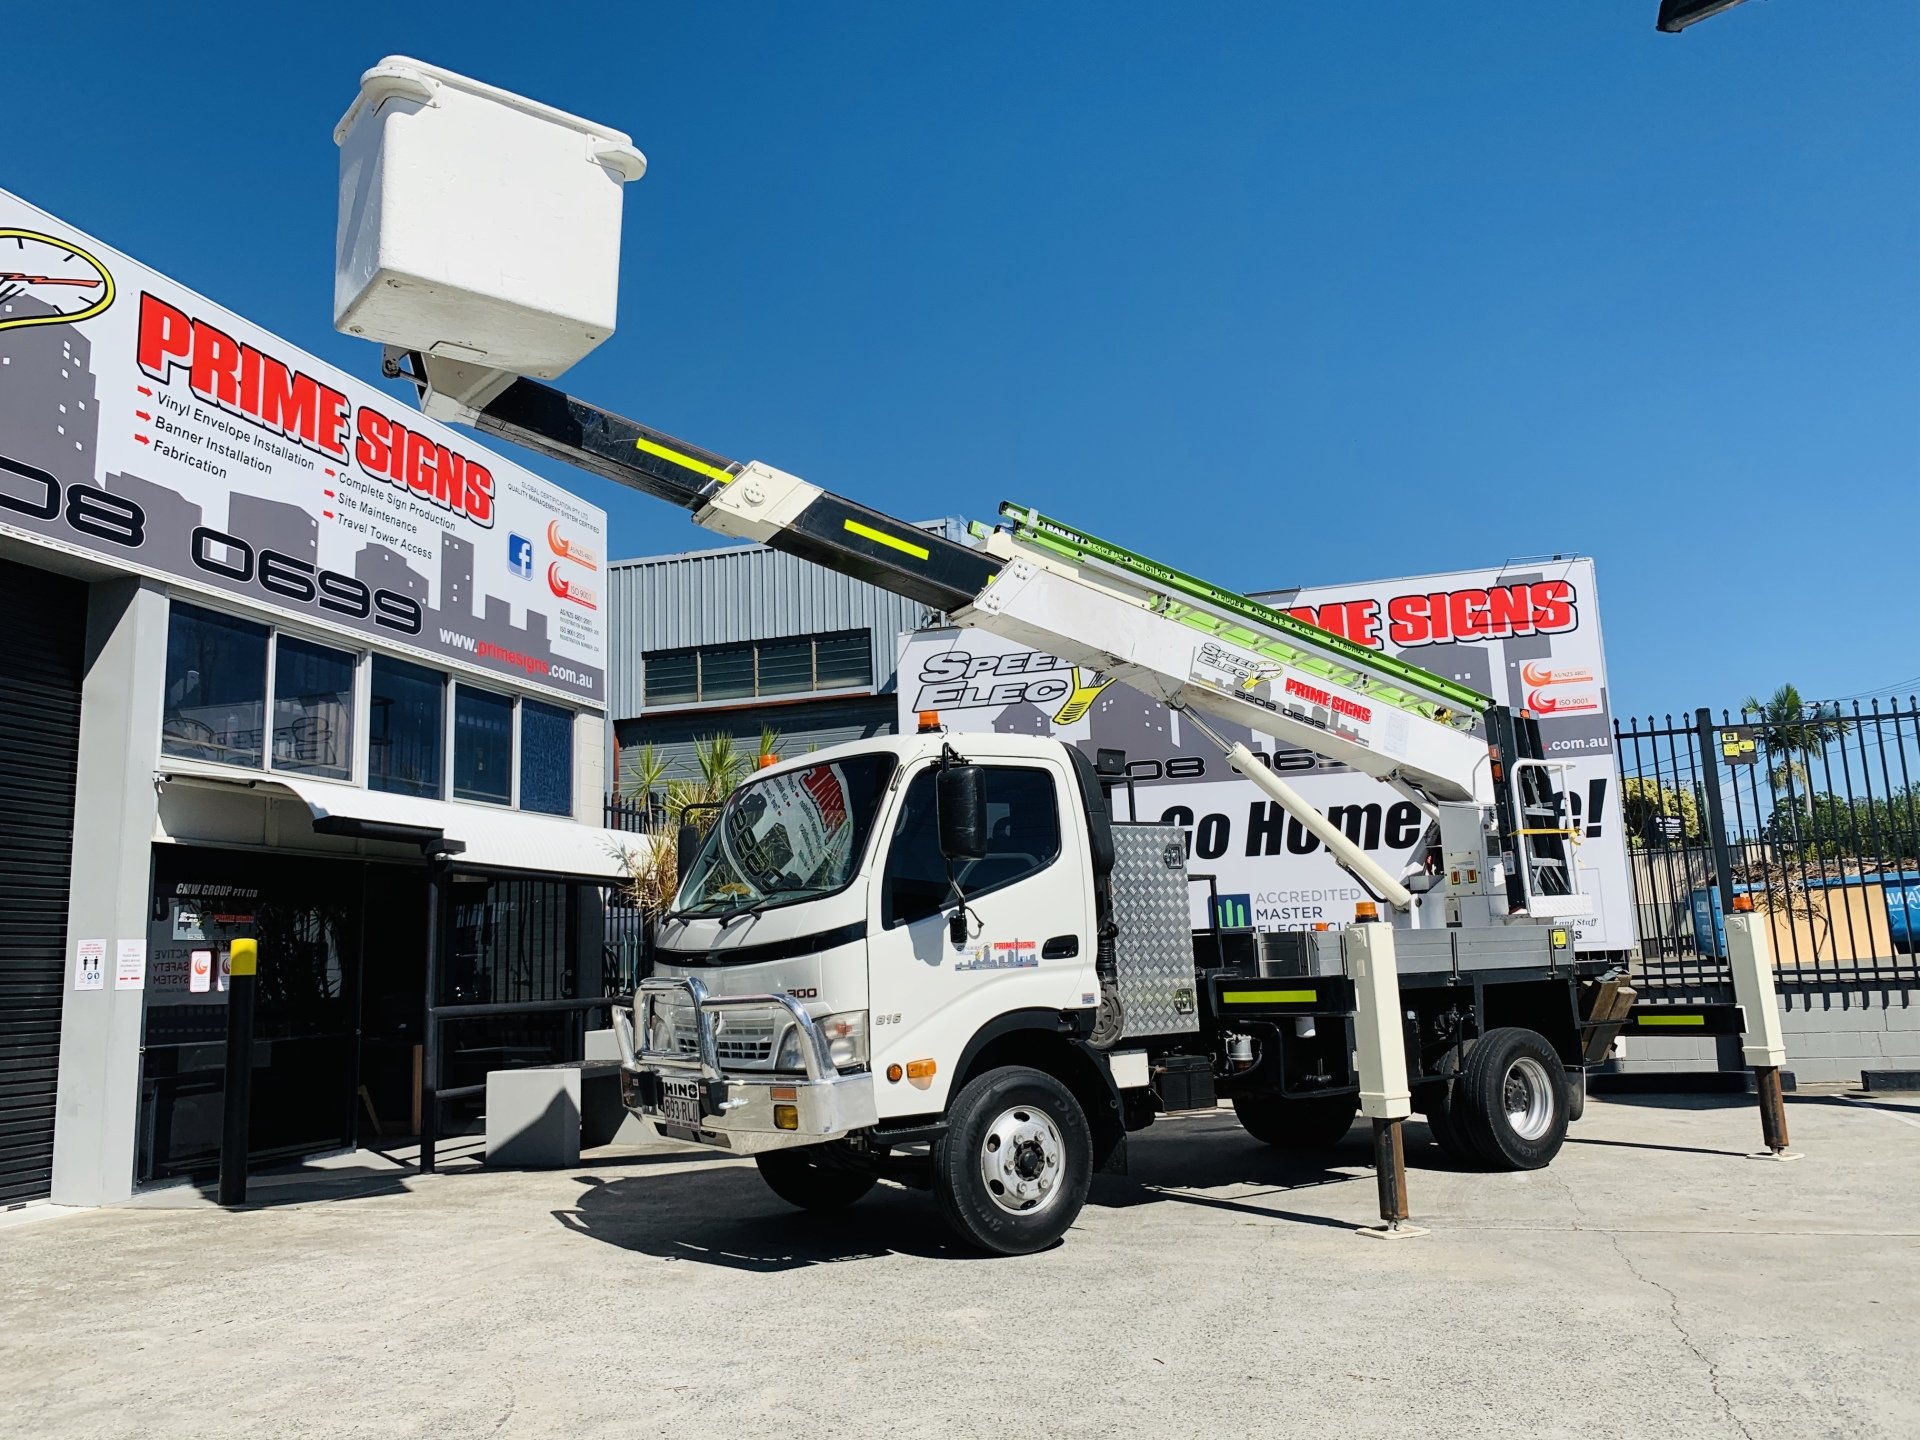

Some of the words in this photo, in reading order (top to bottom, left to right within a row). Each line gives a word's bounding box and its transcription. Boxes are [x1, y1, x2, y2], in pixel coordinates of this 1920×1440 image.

[137, 290, 351, 467] PRIME
[356, 406, 496, 530] SIGNS
[155, 415, 204, 445] Banner
[206, 436, 273, 475] Installation
[158, 391, 190, 417] Vinyl
[193, 408, 251, 442] Envelope
[253, 434, 315, 471] Installation
[153, 439, 228, 479] Fabrication
[338, 493, 357, 510] Site
[359, 501, 418, 534] Maintenance
[339, 472, 385, 501] Complete
[387, 492, 407, 511] Sign
[409, 504, 456, 532] Production
[508, 483, 528, 498] QUALITY
[528, 494, 561, 514] MANAGEMENT
[561, 510, 579, 524] SYSTEM
[541, 490, 572, 511] CERTIFICATION
[338, 513, 368, 533] Travel
[370, 525, 399, 546] Tower
[400, 539, 432, 560] Access
[190, 525, 424, 636] 0699
[570, 585, 580, 597] ISO
[580, 589, 592, 601] 9001
[1388, 579, 1579, 648] SIGNS
[439, 627, 593, 689] www.primesigns.com.au
[1197, 651, 1250, 680] ELEC
[1201, 641, 1260, 671] SPEED
[912, 679, 1068, 713] ELEC
[1234, 689, 1277, 712] 3208
[1282, 707, 1326, 730] 0699
[1285, 677, 1332, 709] PRIME
[1330, 694, 1373, 725] SIGNS
[1573, 697, 1589, 705] 9001
[1245, 800, 1422, 857] Home
[176, 883, 201, 895] CMW
[202, 884, 233, 897] GROUP
[233, 888, 246, 897] PTY
[246, 889, 258, 898] LTD
[1255, 888, 1362, 904] ACCREDITED
[1256, 906, 1323, 920] MASTER
[665, 1081, 698, 1099] HINO
